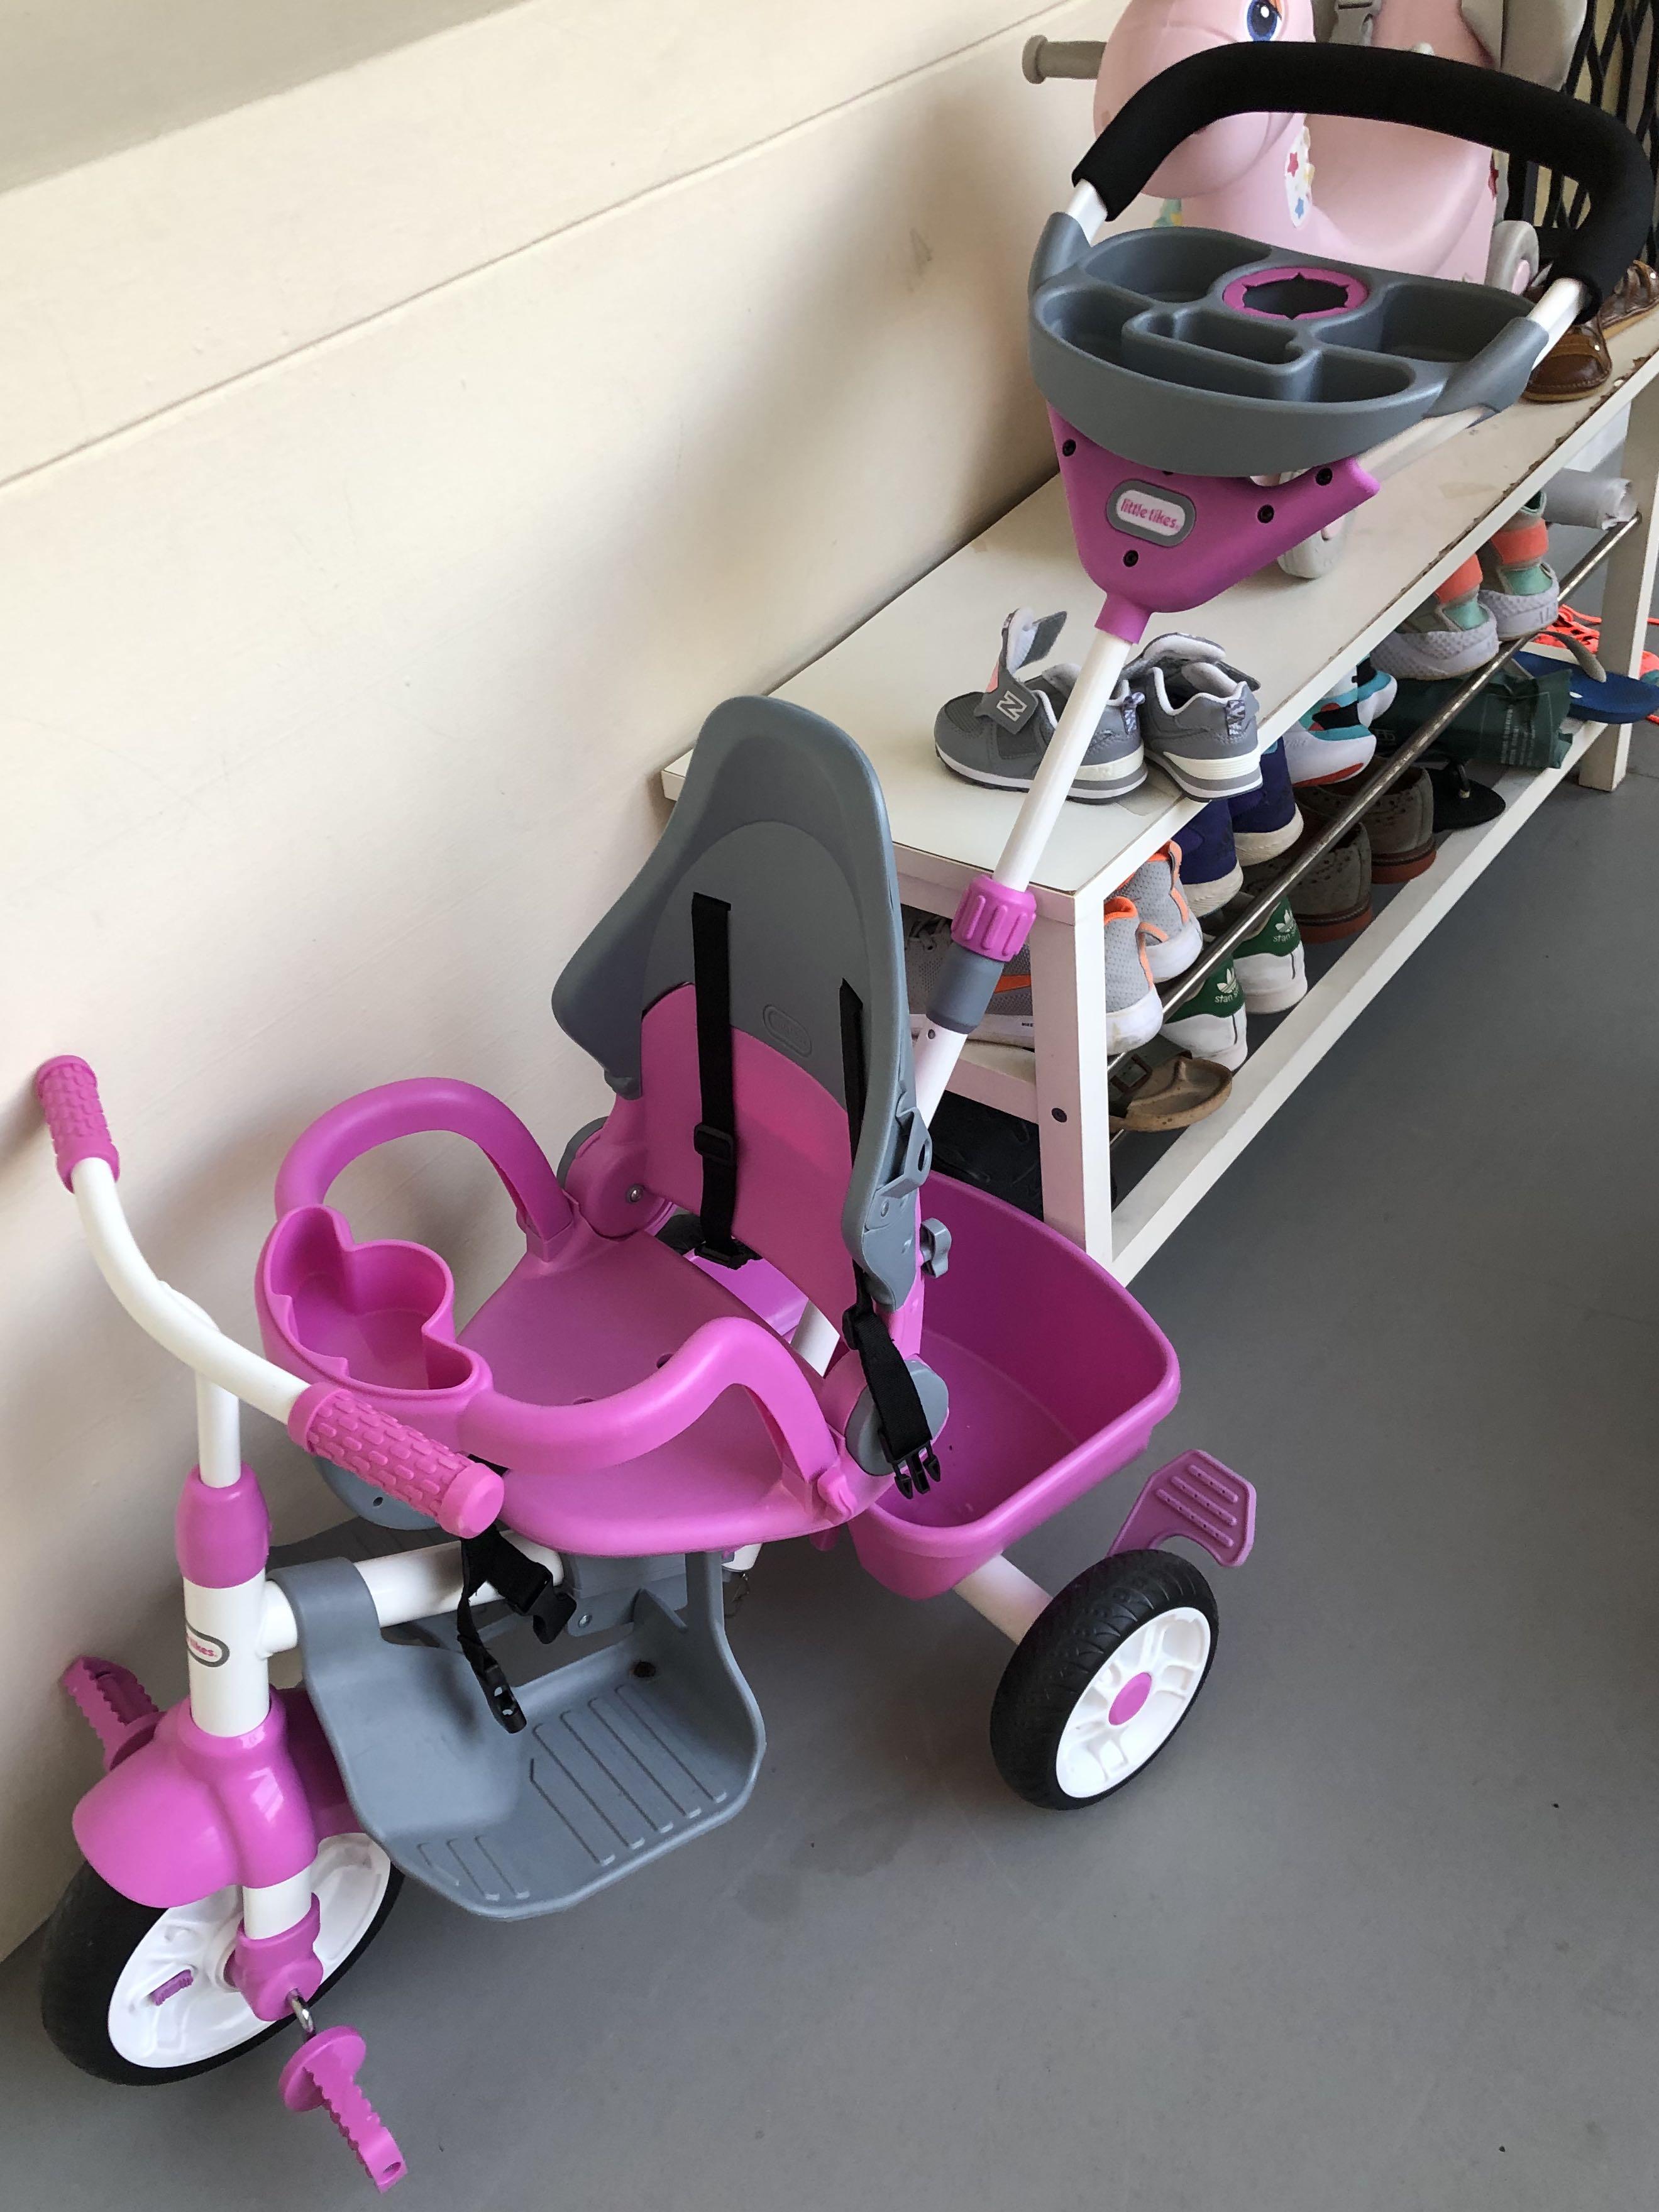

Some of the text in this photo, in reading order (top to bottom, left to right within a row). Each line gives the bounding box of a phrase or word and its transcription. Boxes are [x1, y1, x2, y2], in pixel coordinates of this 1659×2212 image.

[1120, 498, 1177, 528] little tikes
[996, 690, 1027, 722] N
[1215, 994, 1233, 1003] stan
